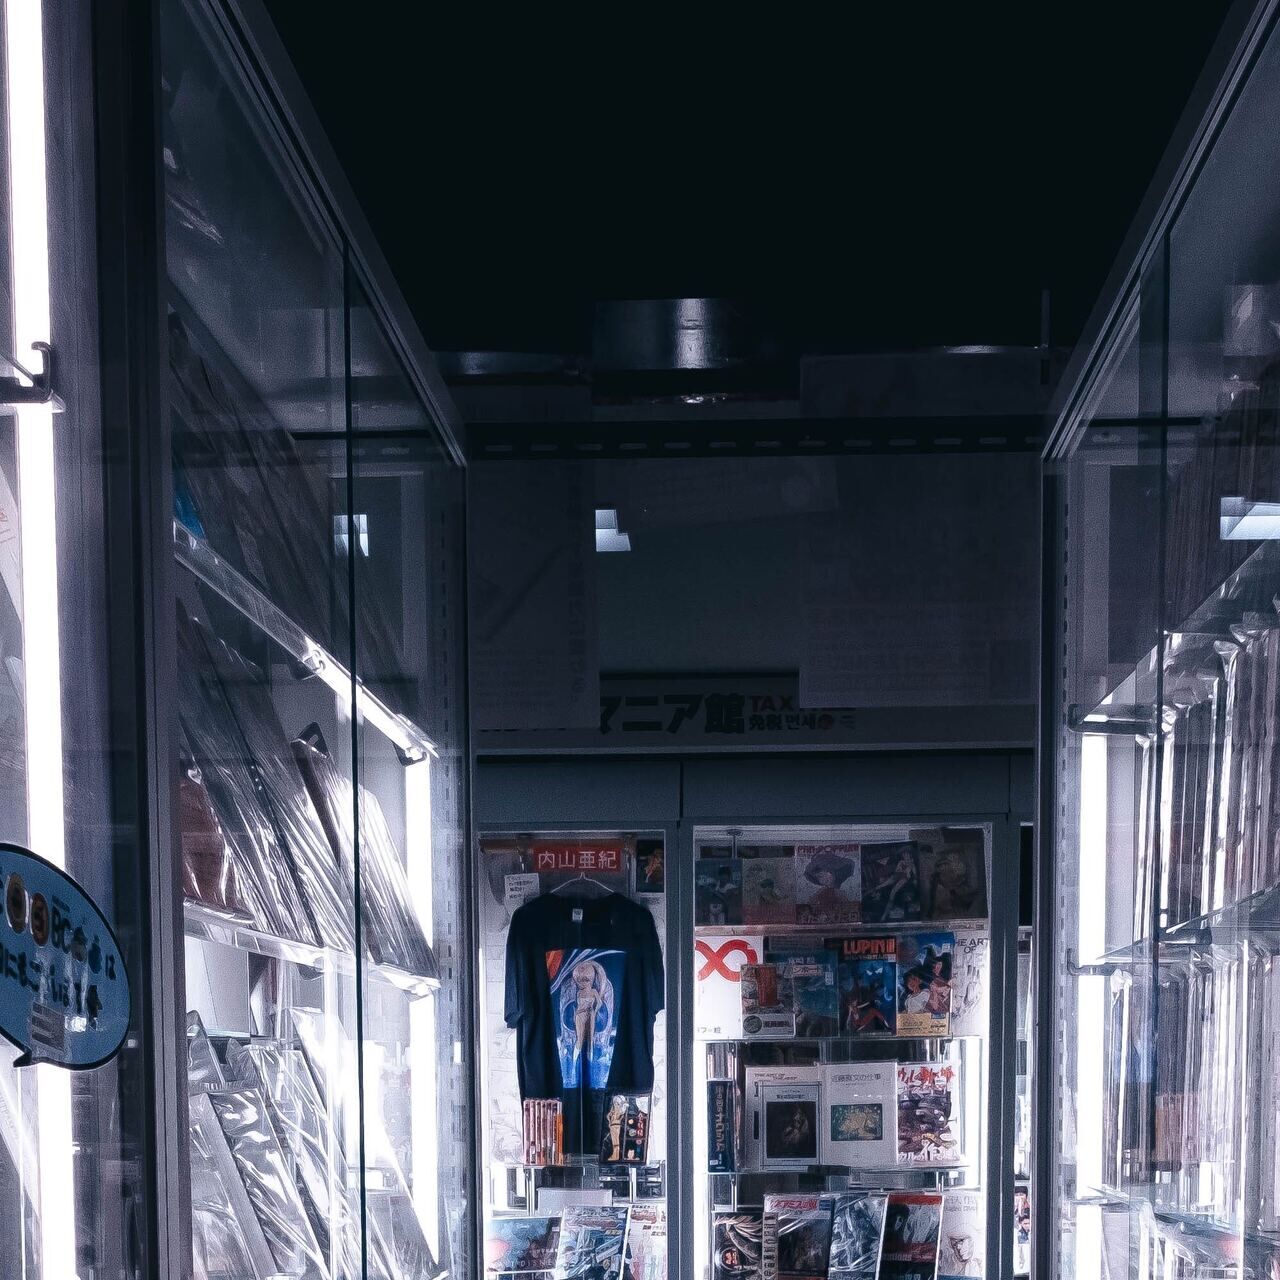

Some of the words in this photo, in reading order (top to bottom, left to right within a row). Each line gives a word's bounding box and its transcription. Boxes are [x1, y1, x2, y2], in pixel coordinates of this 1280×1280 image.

[747, 695, 790, 711] TAX
[538, 850, 617, 869] 内山亜紀
[844, 938, 885, 954] LUPIN
